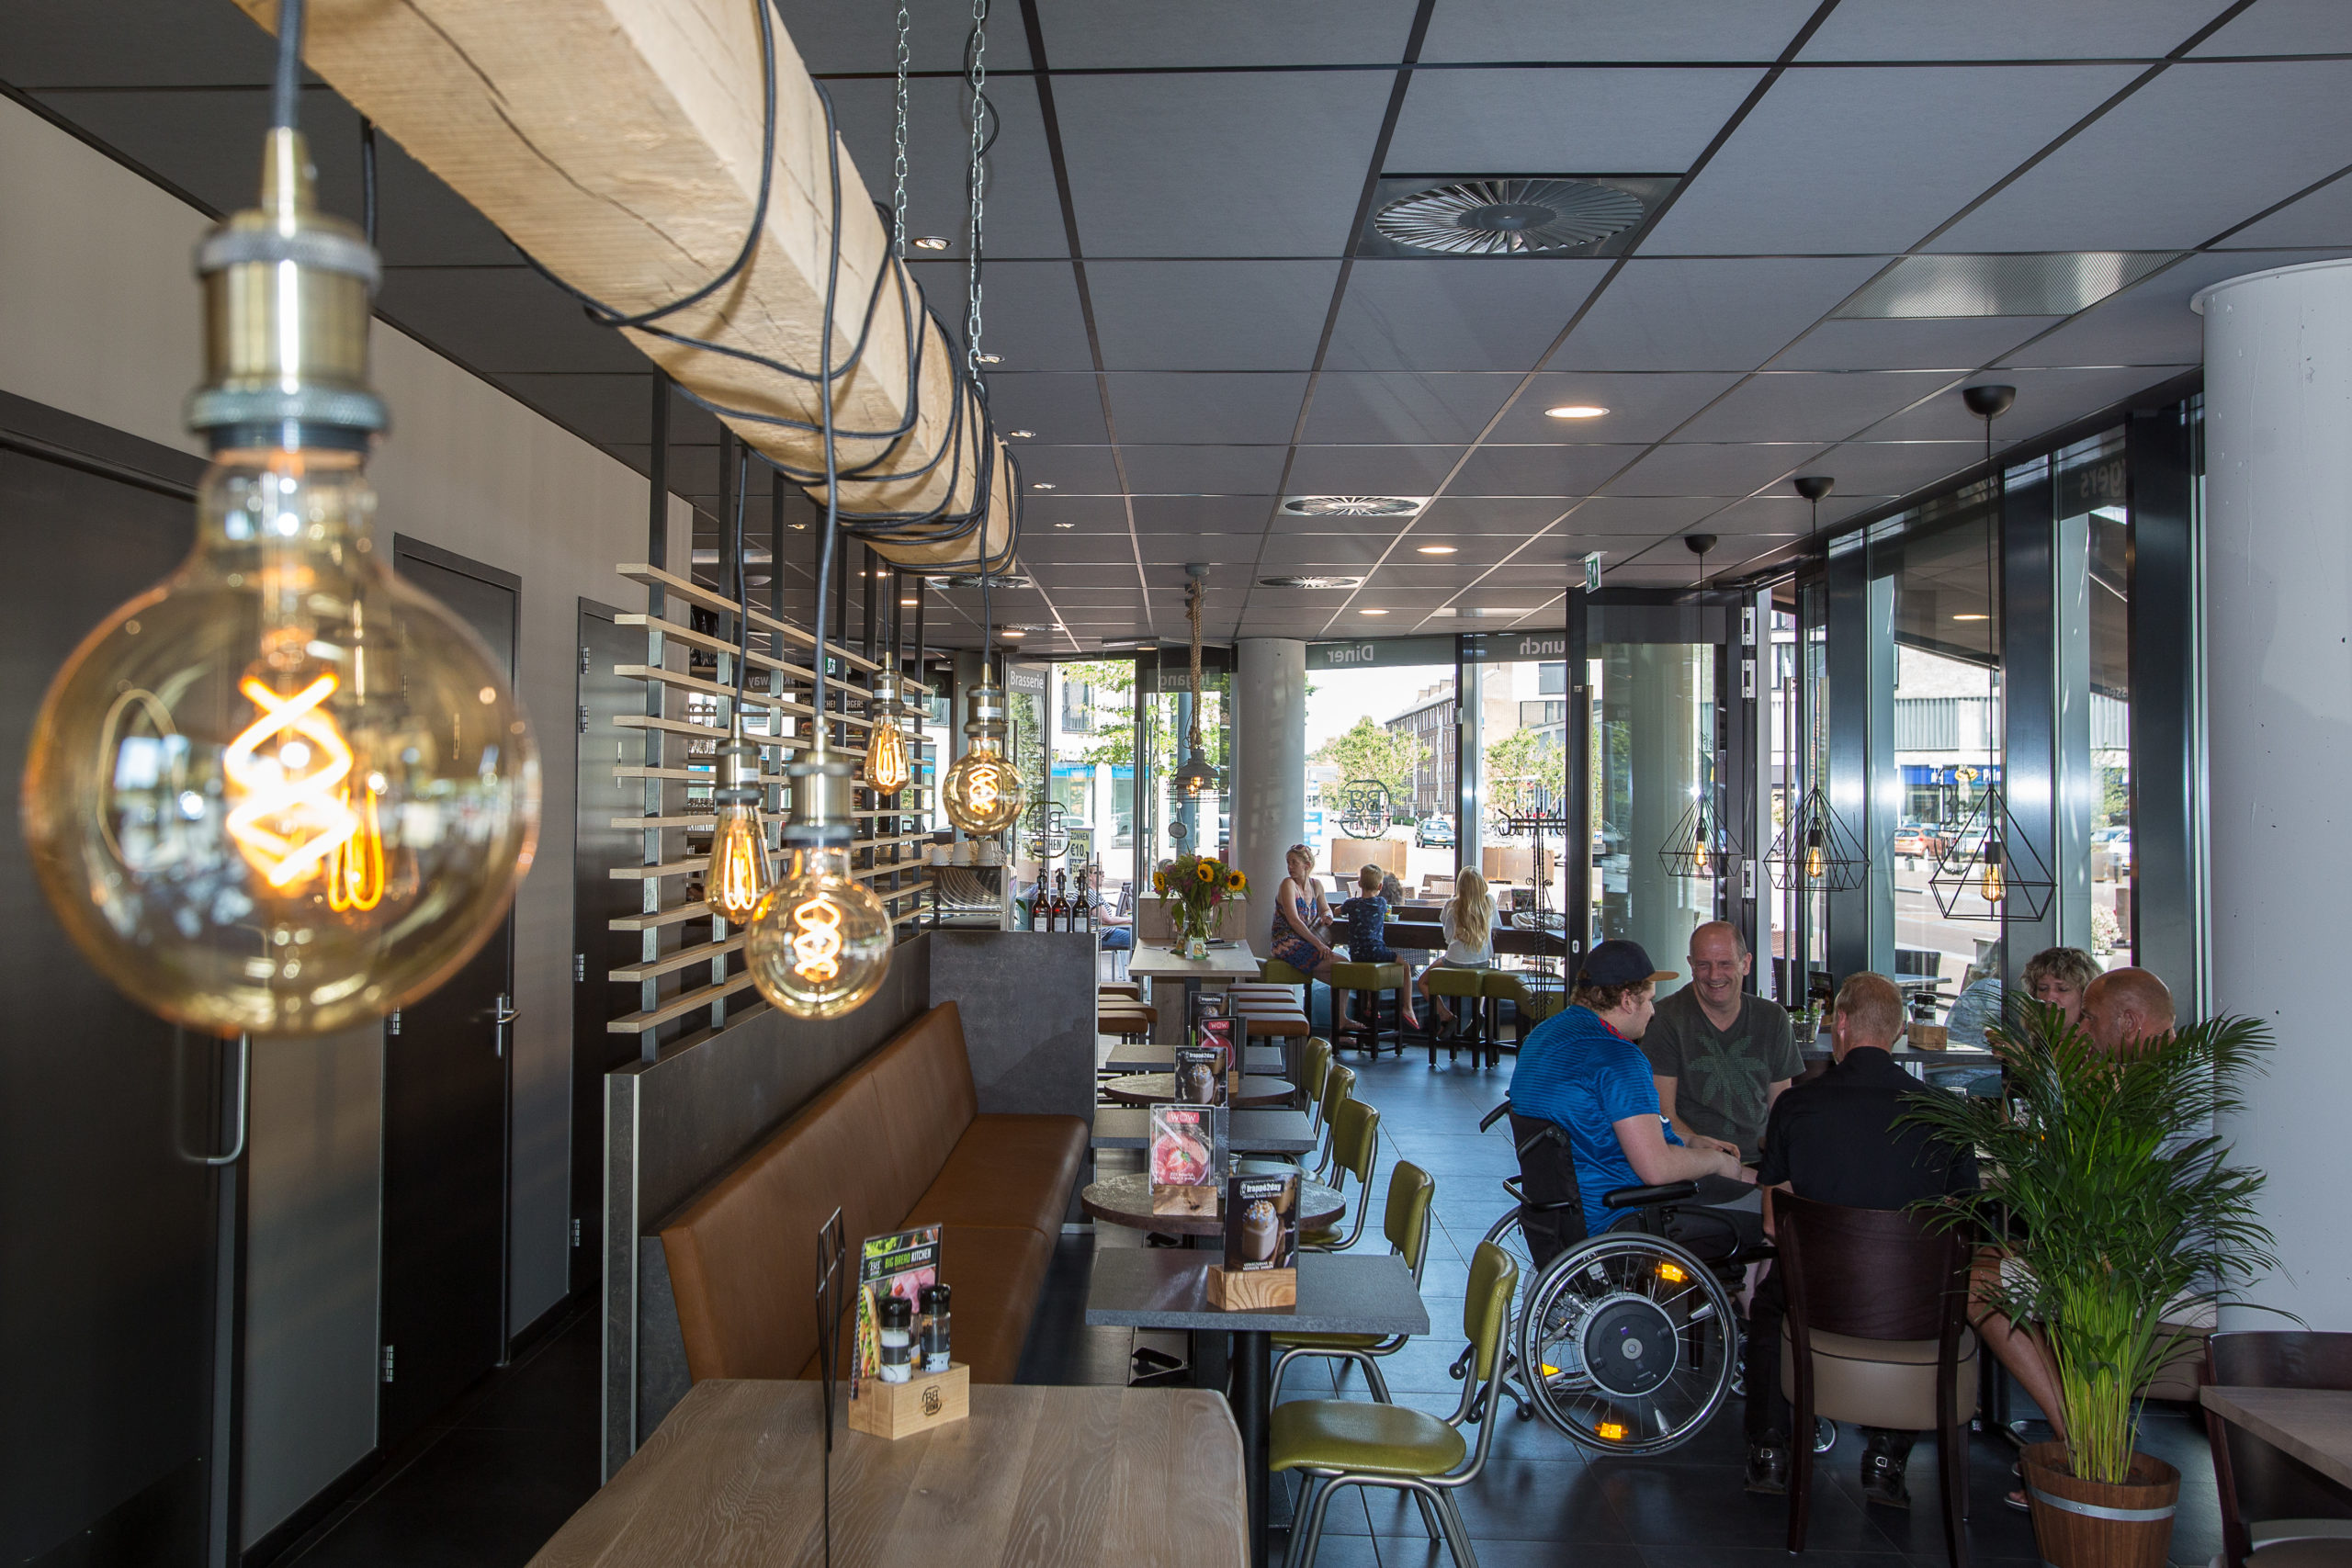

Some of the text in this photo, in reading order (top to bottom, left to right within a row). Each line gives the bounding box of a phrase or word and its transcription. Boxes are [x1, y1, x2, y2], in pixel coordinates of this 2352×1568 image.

[1011, 671, 1045, 690] Brasserie
[1247, 1182, 1282, 1193] frappé2day
[884, 1255, 894, 1269] BIG
[894, 1252, 911, 1267] BREAD
[910, 1247, 932, 1262] KITCHEN
